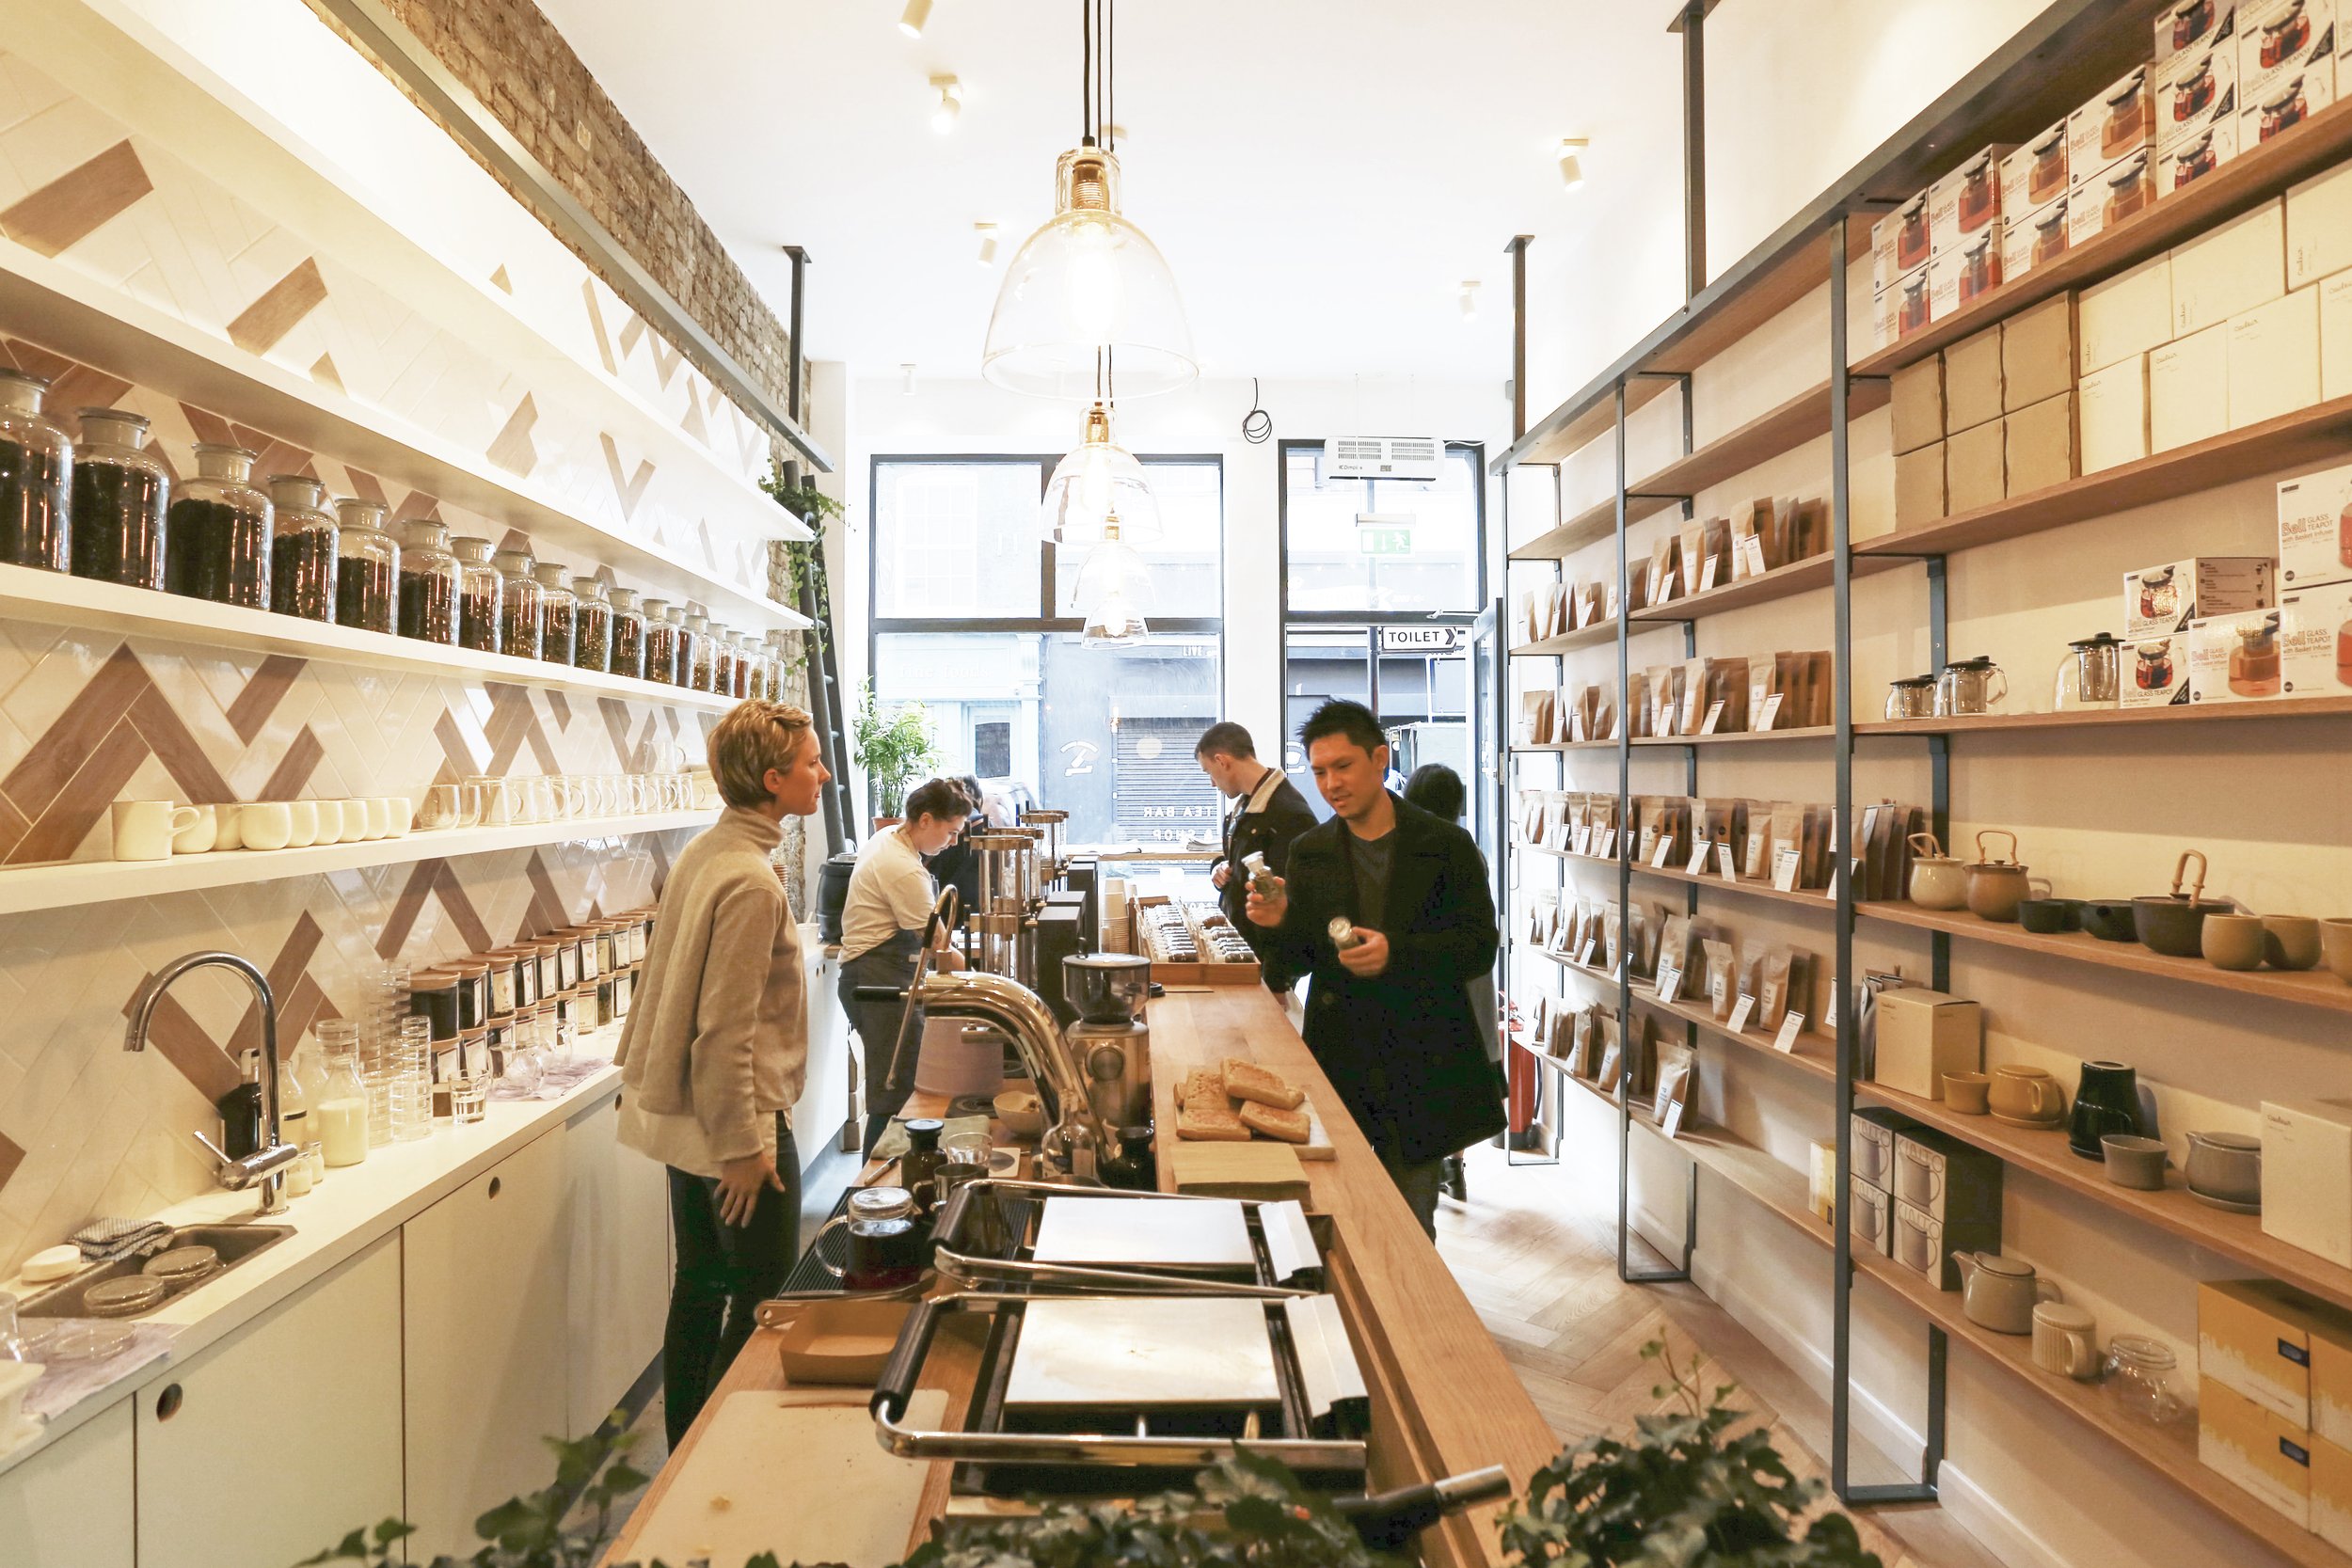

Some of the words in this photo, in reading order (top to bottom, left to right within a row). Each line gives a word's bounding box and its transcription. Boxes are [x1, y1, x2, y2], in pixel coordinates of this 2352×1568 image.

[2307, 514, 2329, 525] GLASS
[2281, 517, 2307, 537] Bell
[2308, 520, 2333, 531] TEAPOT
[1389, 631, 1440, 643] TOILET
[2306, 628, 2328, 638] GLASS
[2307, 635, 2331, 645] TEAPOT
[1183, 645, 1202, 657] LIVE
[2137, 689, 2153, 698] GLASS
[2153, 688, 2173, 696] TEAPOT
